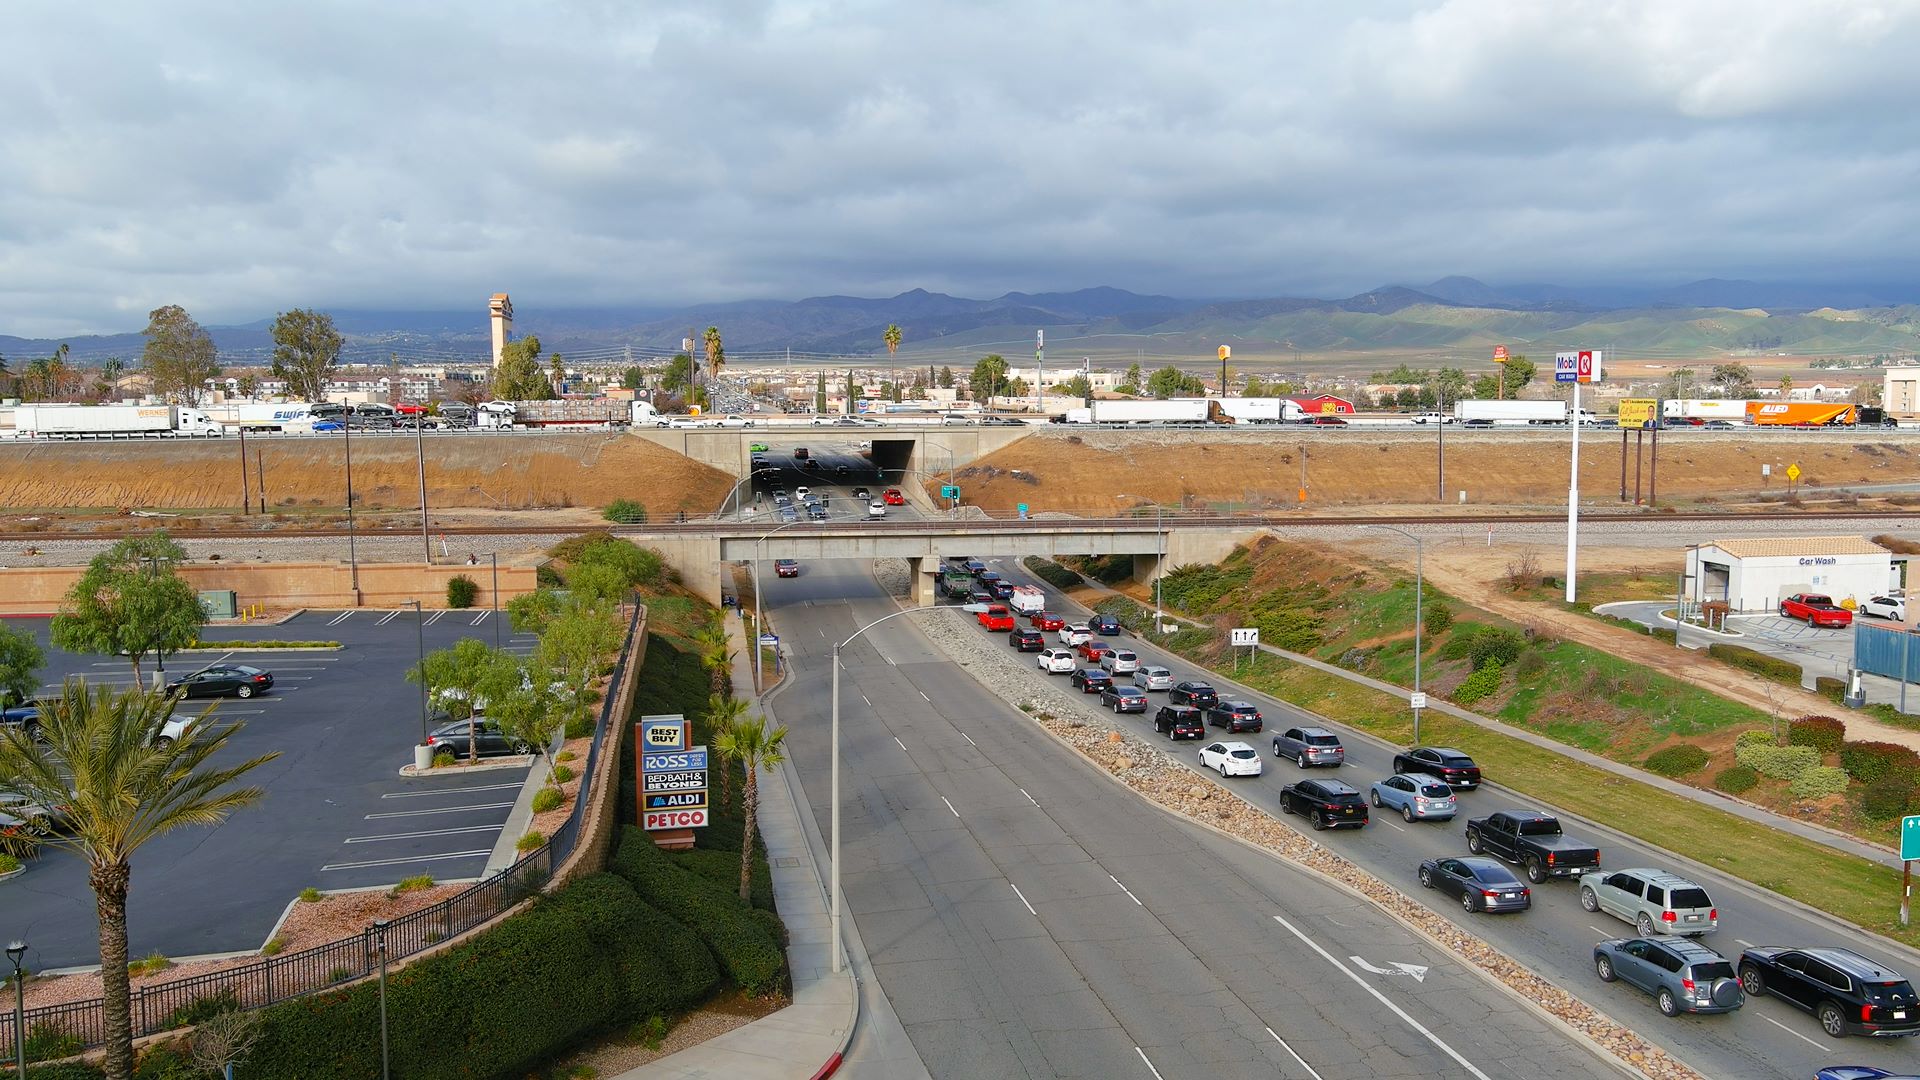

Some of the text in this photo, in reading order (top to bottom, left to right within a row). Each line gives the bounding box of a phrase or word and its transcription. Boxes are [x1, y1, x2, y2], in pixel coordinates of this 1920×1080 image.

[1557, 356, 1577, 369] Mobil
[274, 408, 312, 418] SWIFT
[1815, 557, 1836, 565] Wash
[646, 755, 688, 769] ROSS
[668, 773, 693, 781] BATH
[693, 772, 702, 780] &
[648, 781, 703, 789] BEYOND
[667, 794, 700, 806] ALDI
[647, 811, 705, 828] PETCO
